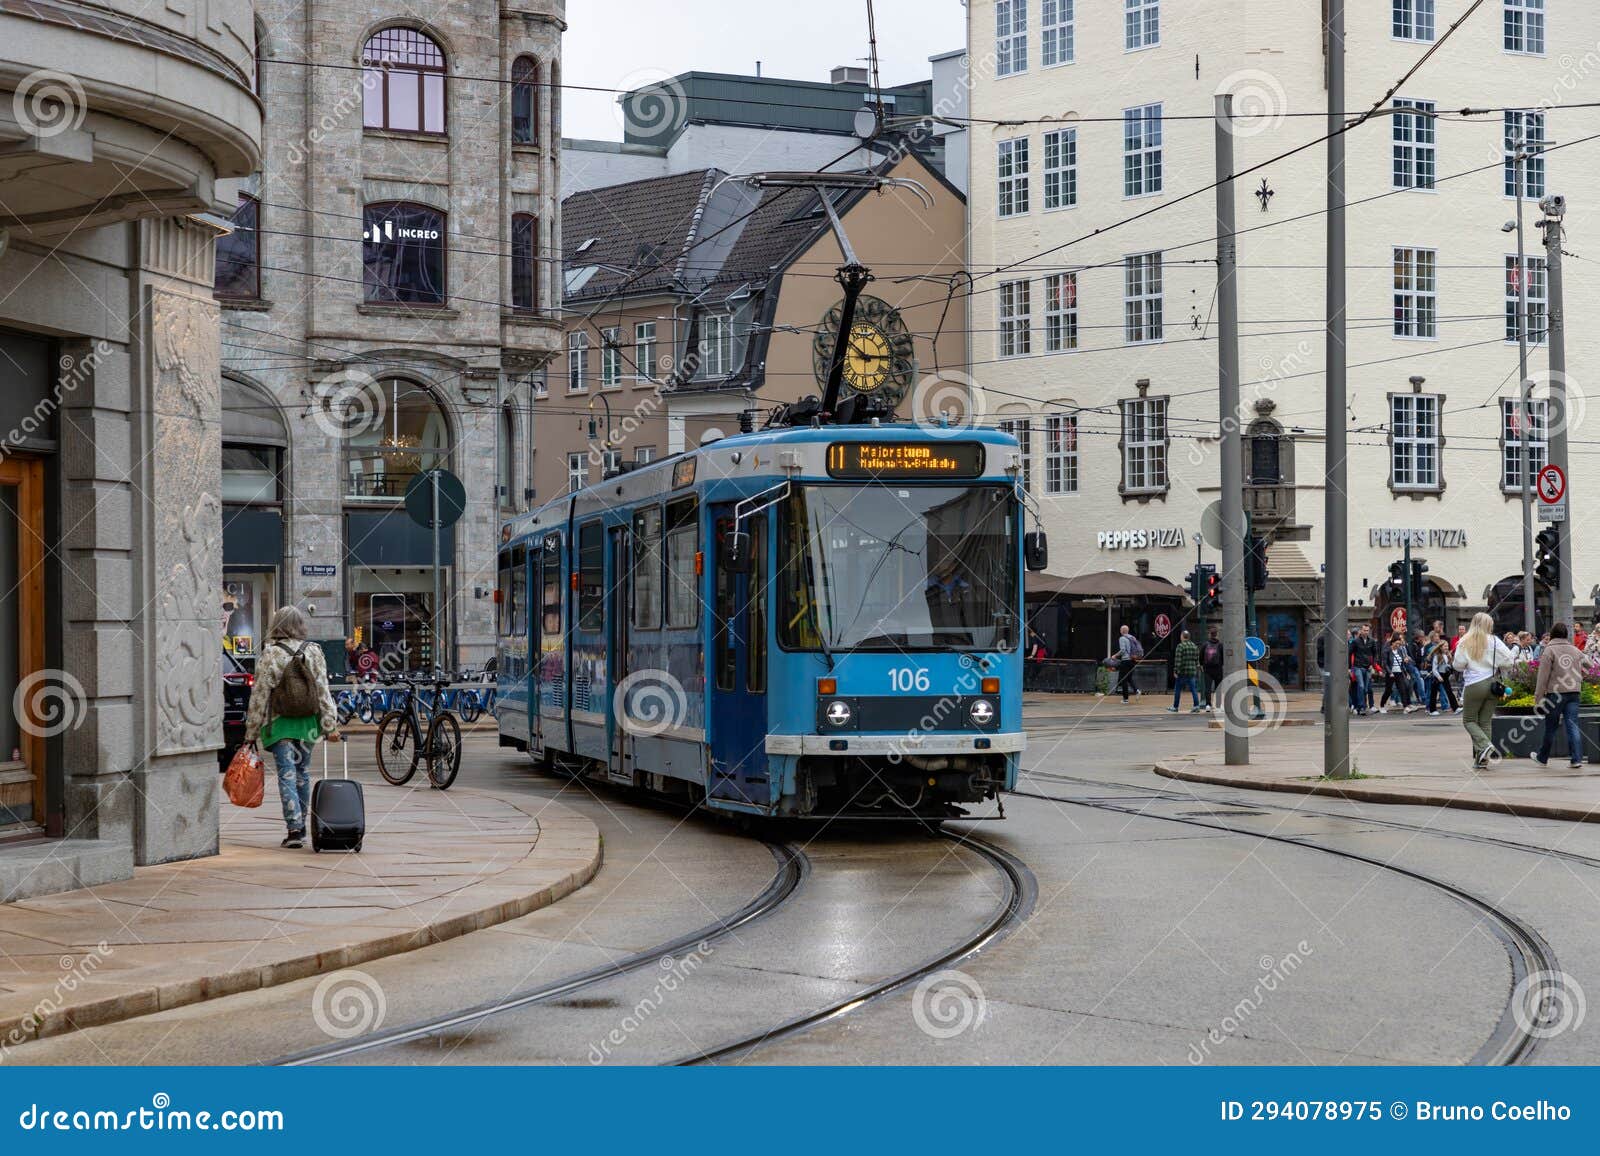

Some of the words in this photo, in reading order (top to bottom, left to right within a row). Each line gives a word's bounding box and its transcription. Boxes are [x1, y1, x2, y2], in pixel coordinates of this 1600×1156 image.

[398, 228, 438, 240] INCREO
[830, 446, 845, 469] 11
[1097, 529, 1147, 550] PEPPES
[1150, 527, 1185, 548] PIZZA
[1369, 528, 1426, 548] PEPPES
[1429, 528, 1467, 548] PIZZA
[888, 668, 930, 691] 106
